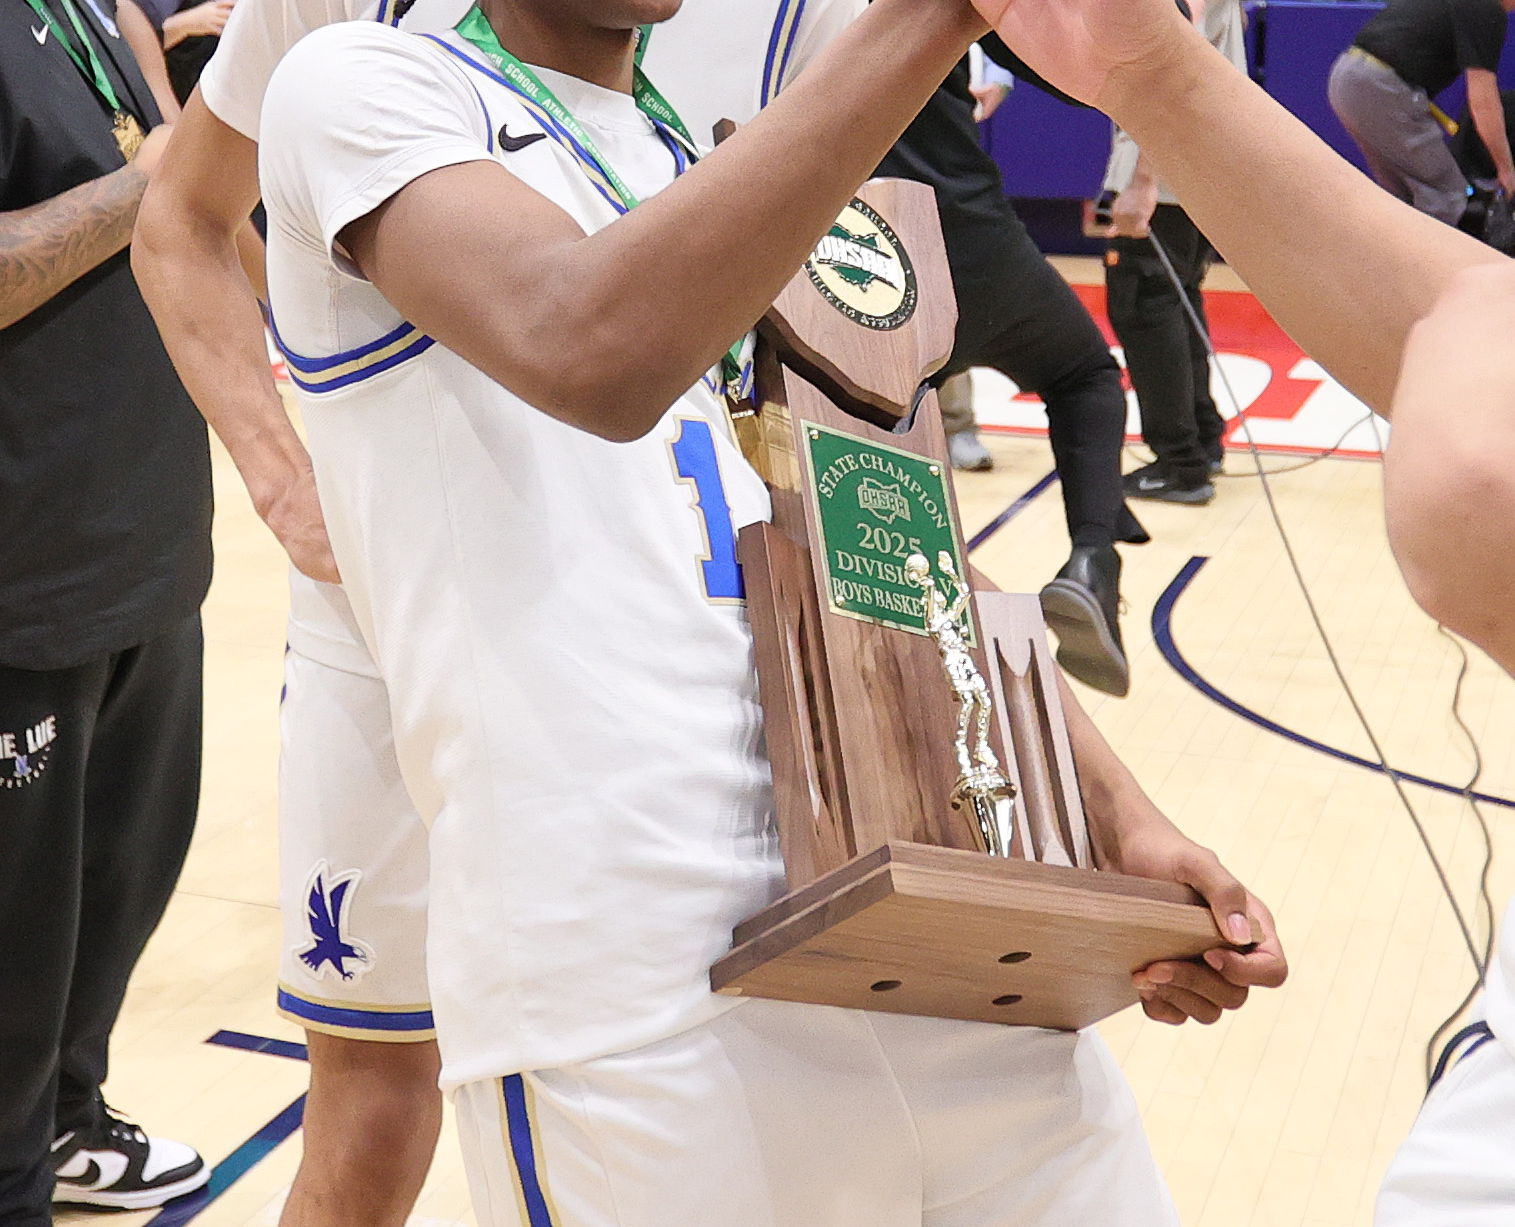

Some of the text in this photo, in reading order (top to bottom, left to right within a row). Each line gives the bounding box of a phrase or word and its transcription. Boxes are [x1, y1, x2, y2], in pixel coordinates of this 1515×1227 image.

[504, 62, 542, 99] SCHOOL
[541, 98, 585, 139] ATHLETIC
[641, 92, 674, 123] SCHOOL
[663, 413, 747, 606] 1
[818, 452, 948, 530] STATE CHAMPION
[857, 522, 924, 560] 2025
[831, 576, 873, 605] BOYS
[25, 714, 58, 754] LUE
